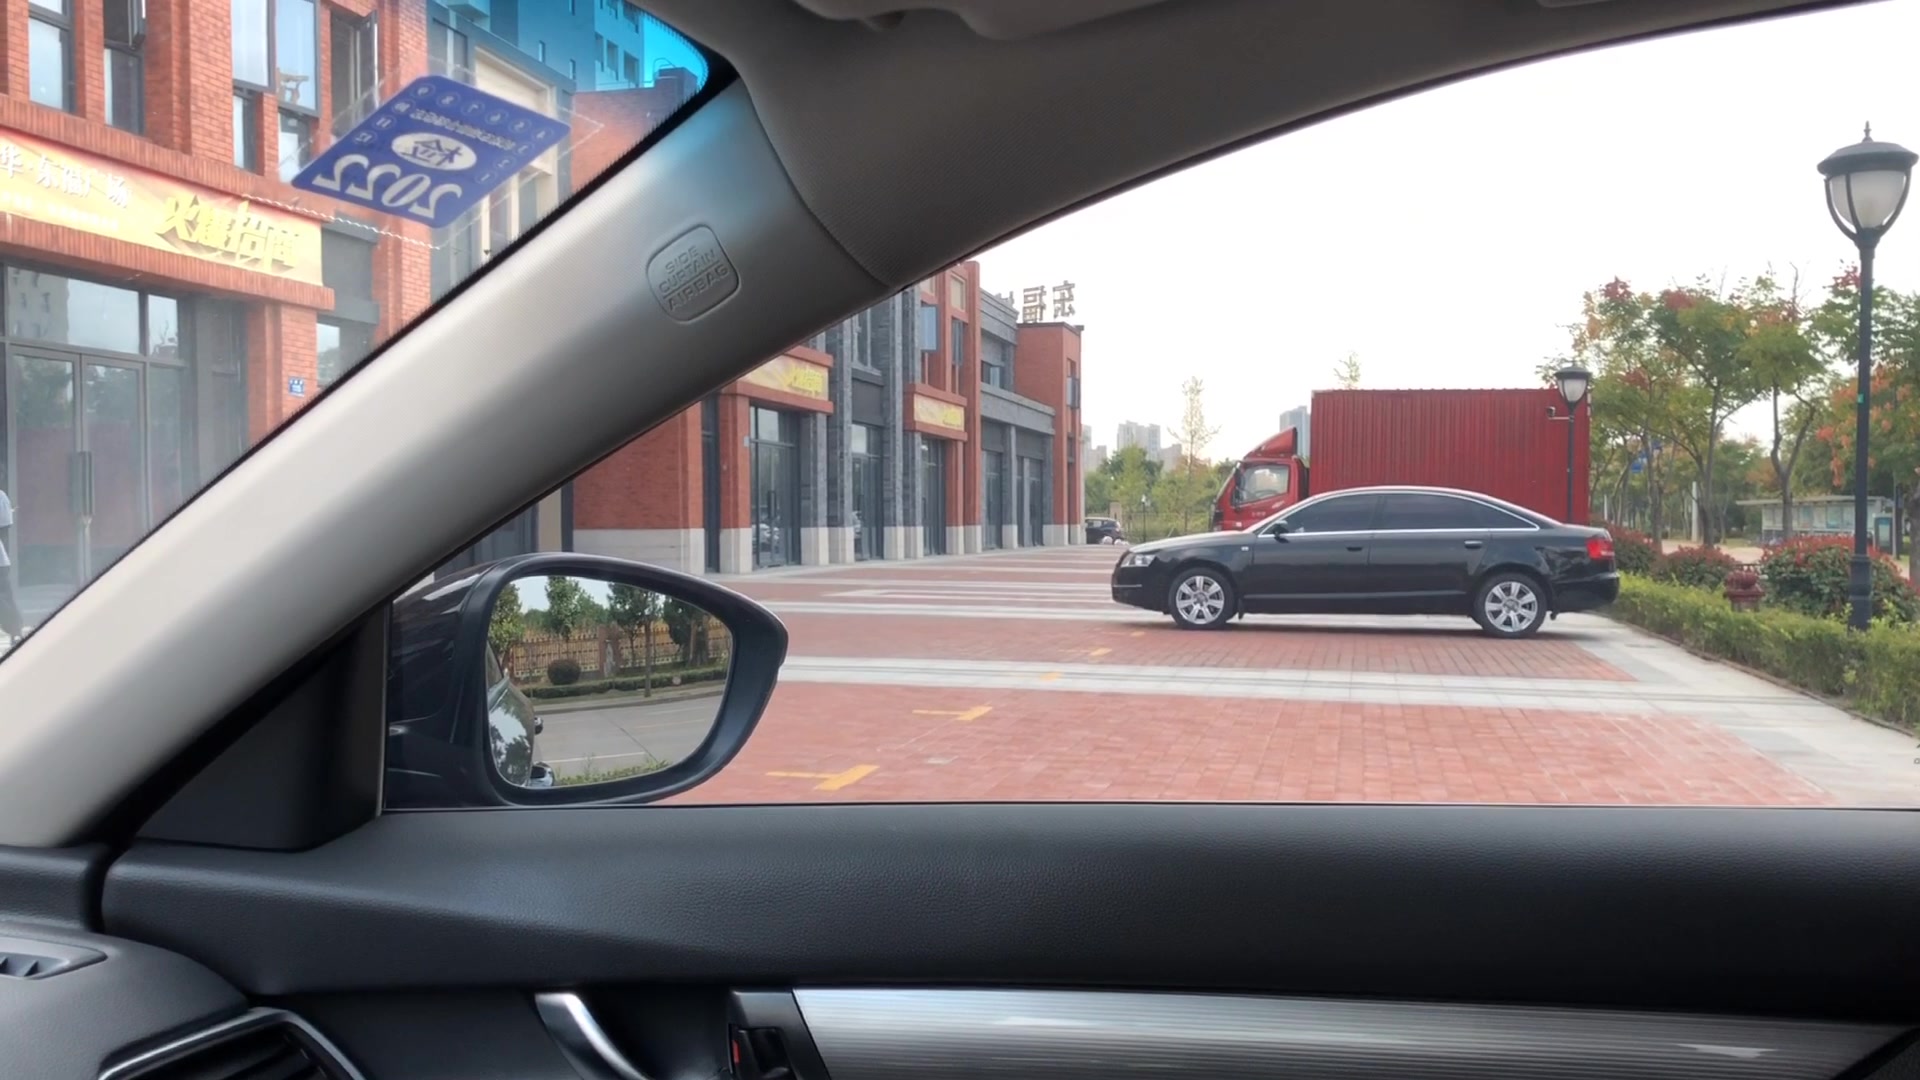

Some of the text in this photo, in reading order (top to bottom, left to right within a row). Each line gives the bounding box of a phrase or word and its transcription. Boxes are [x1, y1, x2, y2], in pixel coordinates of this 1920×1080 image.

[658, 249, 715, 294] CURTAIN
[665, 245, 698, 275] SIDE
[668, 263, 729, 311] AIRBAG
